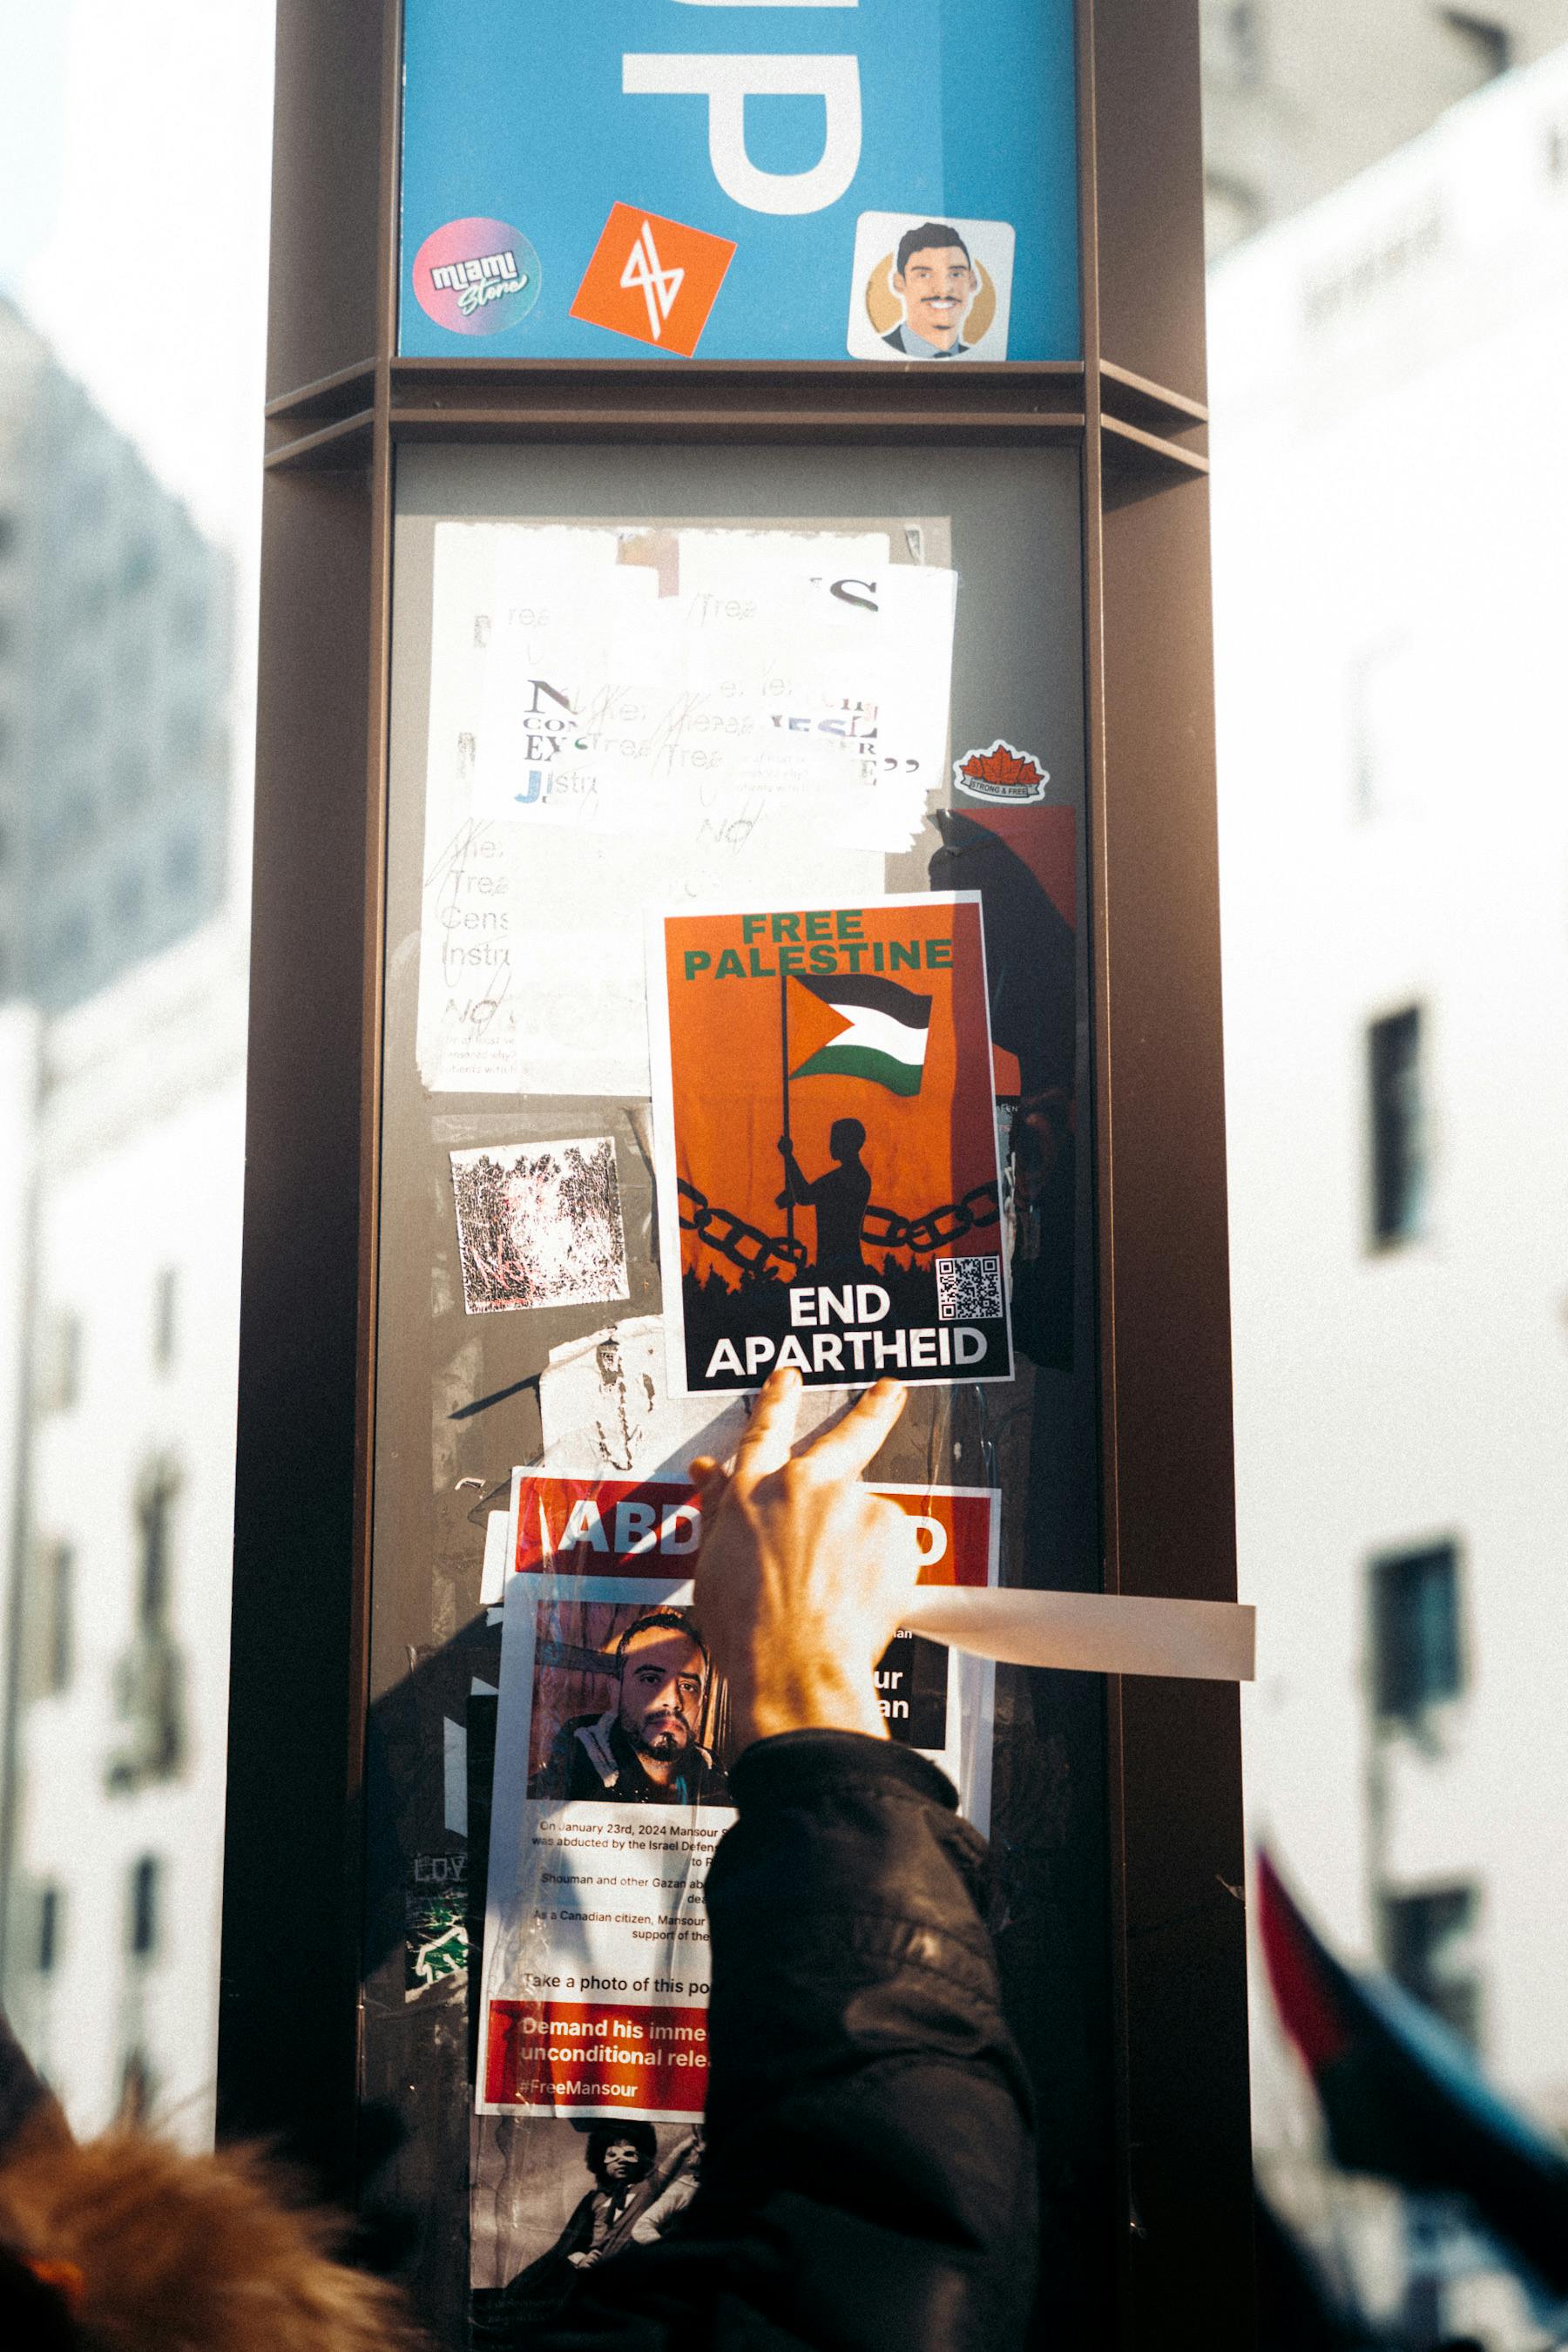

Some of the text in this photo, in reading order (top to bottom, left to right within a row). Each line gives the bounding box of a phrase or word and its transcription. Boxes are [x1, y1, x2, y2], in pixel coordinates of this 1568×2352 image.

[622, 0, 862, 216] P
[457, 274, 528, 316] Store
[971, 780, 1028, 796] STRONG & FREE
[742, 909, 865, 945] FREE
[684, 938, 955, 982] PALESTINE
[789, 1284, 890, 1327] END
[705, 1327, 988, 1378] APARTHEID
[540, 1821, 556, 1831] On
[559, 1821, 603, 1834] January
[607, 1823, 635, 1835] 23rd,
[639, 1825, 666, 1835] 2024
[670, 1826, 718, 1838] Mansour
[532, 1836, 717, 1853] was abducted by the Israel Defen
[692, 1857, 702, 1867] to
[542, 1873, 593, 1884] Shouman
[597, 1876, 617, 1886] and
[620, 1877, 648, 1887] other
[652, 1878, 686, 1889] Gazan
[559, 1909, 612, 1922] Canadian
[615, 1913, 654, 1925] citizen,
[658, 1915, 706, 1926] Mansour
[632, 1930, 710, 1942] support of the
[524, 1973, 711, 1997] Take a photo of this po
[523, 2017, 707, 2042] Demand his imme
[521, 2044, 708, 2068] unconditional rele
[519, 2078, 639, 2098] #FreeMansour
